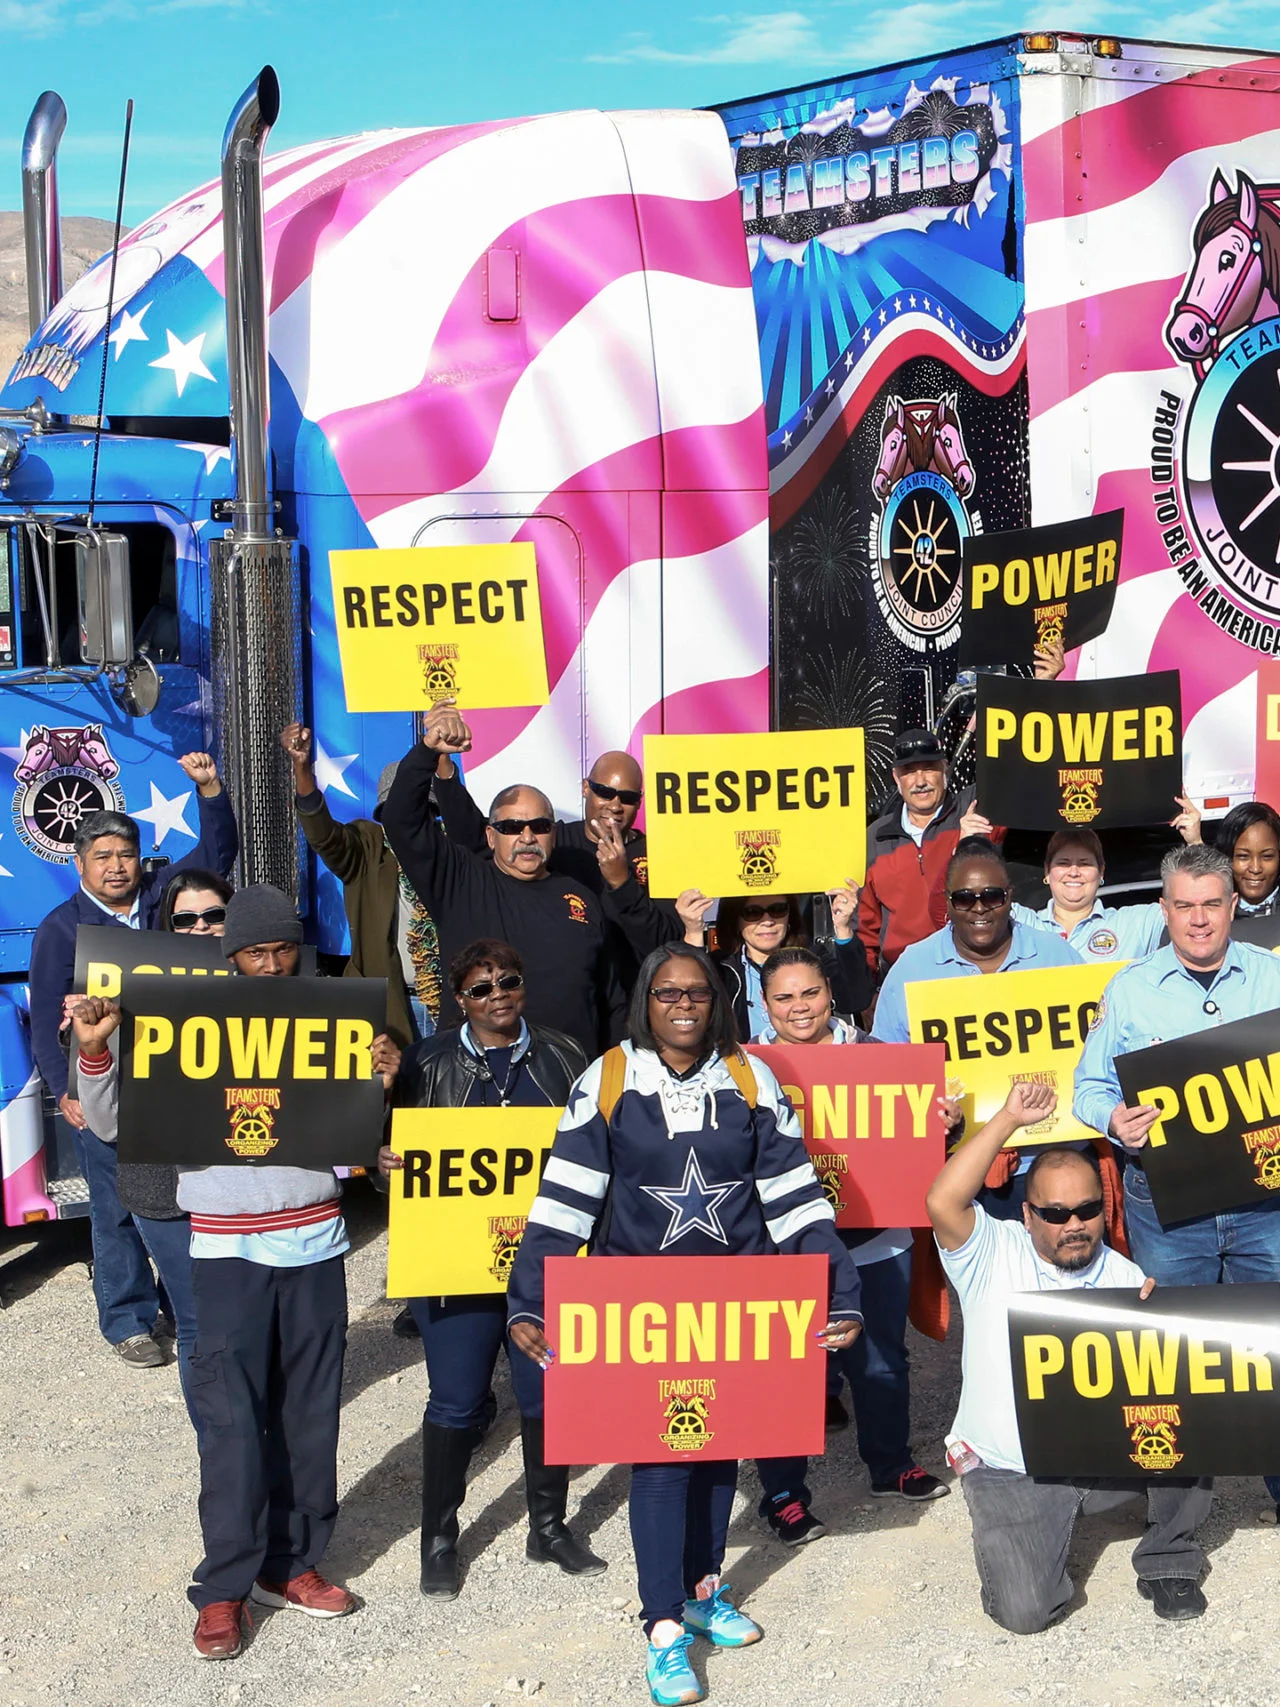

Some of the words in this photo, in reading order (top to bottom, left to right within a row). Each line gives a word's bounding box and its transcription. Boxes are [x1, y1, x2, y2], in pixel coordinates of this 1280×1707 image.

[738, 130, 979, 221] TEAMSTERS
[1151, 389, 1181, 483] PROUD
[894, 474, 952, 501] TEAMSTERS
[1153, 486, 1179, 523] TO
[868, 512, 880, 559] PROUD
[915, 537, 933, 565] 42
[1162, 525, 1191, 563] BE
[870, 560, 880, 579] TO
[971, 539, 1118, 610] POWER
[1177, 559, 1209, 597] AN
[1206, 528, 1279, 600] JOINT
[343, 579, 528, 628] RESPECT
[873, 580, 885, 600] BE
[878, 597, 891, 618] AN
[888, 583, 917, 622] JOINT
[1033, 602, 1068, 624] TEAMSTERS
[886, 613, 926, 653] AMERICAN
[934, 622, 962, 652] PROUD
[985, 705, 1175, 763] POWER
[656, 765, 855, 814] RESPECT
[1058, 769, 1103, 786] TEAMSTERS
[31, 845, 70, 864] AMERICAN
[112, 781, 127, 814] AMSTER
[60, 803, 77, 818] 42
[31, 829, 60, 850] JOINT
[735, 829, 781, 849] TEAMSTERS
[133, 1015, 374, 1080] POWER
[921, 1001, 1100, 1061] RESPEC
[225, 1088, 281, 1110] TEAMSTERS
[781, 1084, 936, 1139] NITY
[402, 1148, 552, 1198] RESP
[809, 1154, 848, 1174] MSTERS
[487, 1216, 528, 1238] TEAMSTE
[559, 1300, 817, 1364] DIGNITY
[1023, 1330, 1274, 1399] POWER
[658, 1378, 716, 1402] TEAMSTERS
[1122, 1404, 1181, 1428] TEAMSTERS
